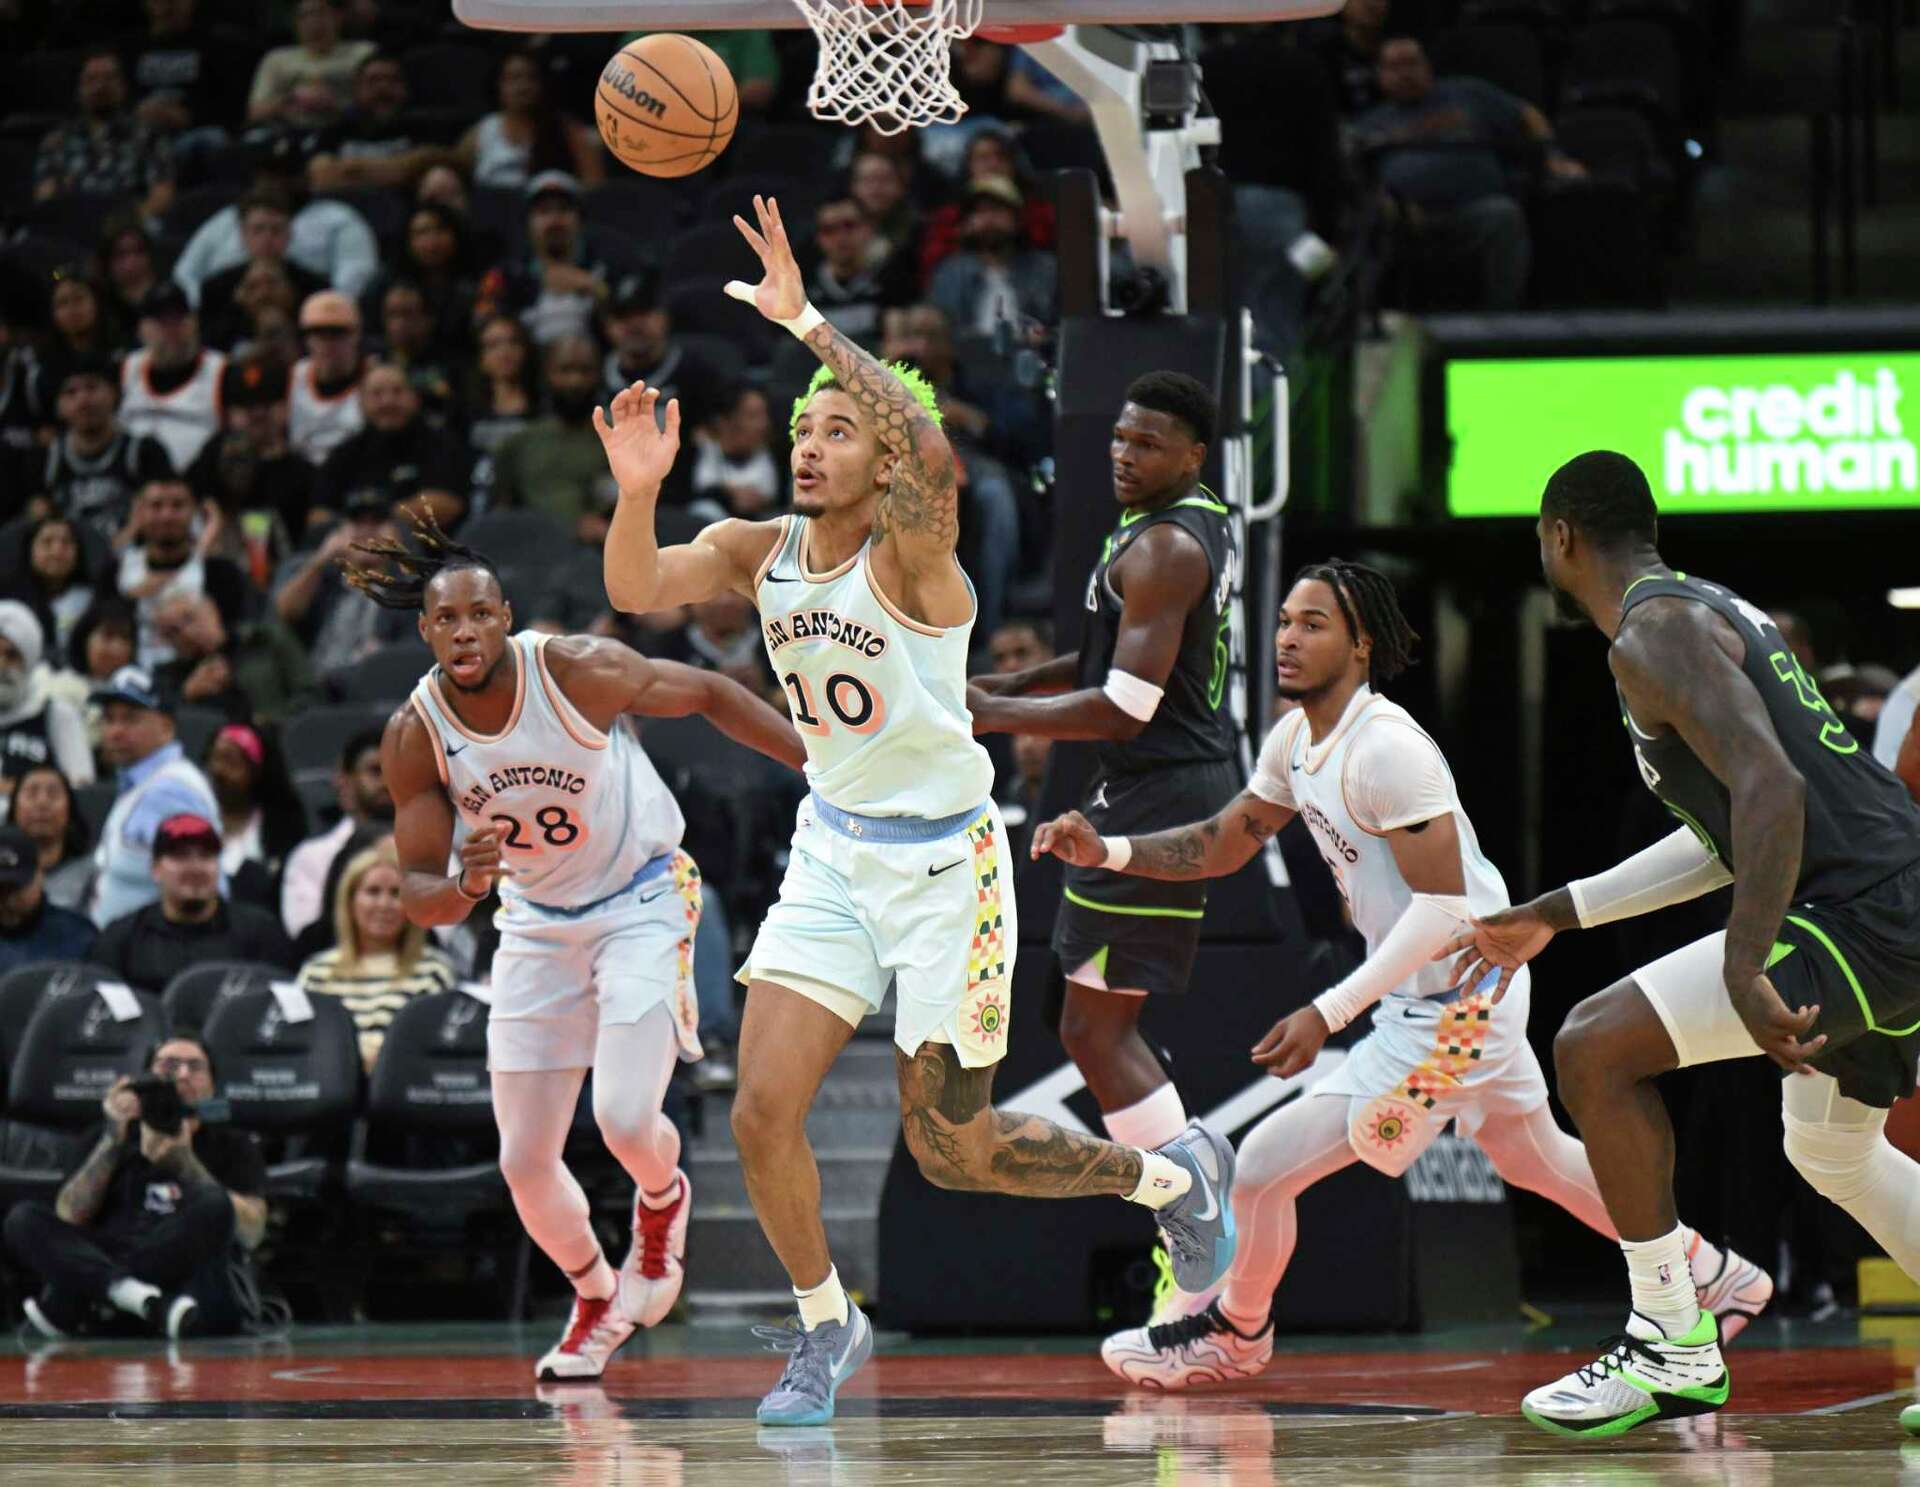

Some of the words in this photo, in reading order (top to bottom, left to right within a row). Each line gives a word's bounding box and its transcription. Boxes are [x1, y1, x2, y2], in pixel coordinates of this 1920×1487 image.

[1683, 367, 1902, 441] credit
[1664, 427, 1917, 495] human
[784, 672, 874, 727] 10
[489, 766, 586, 795] ANTONIO
[490, 805, 579, 850] 28
